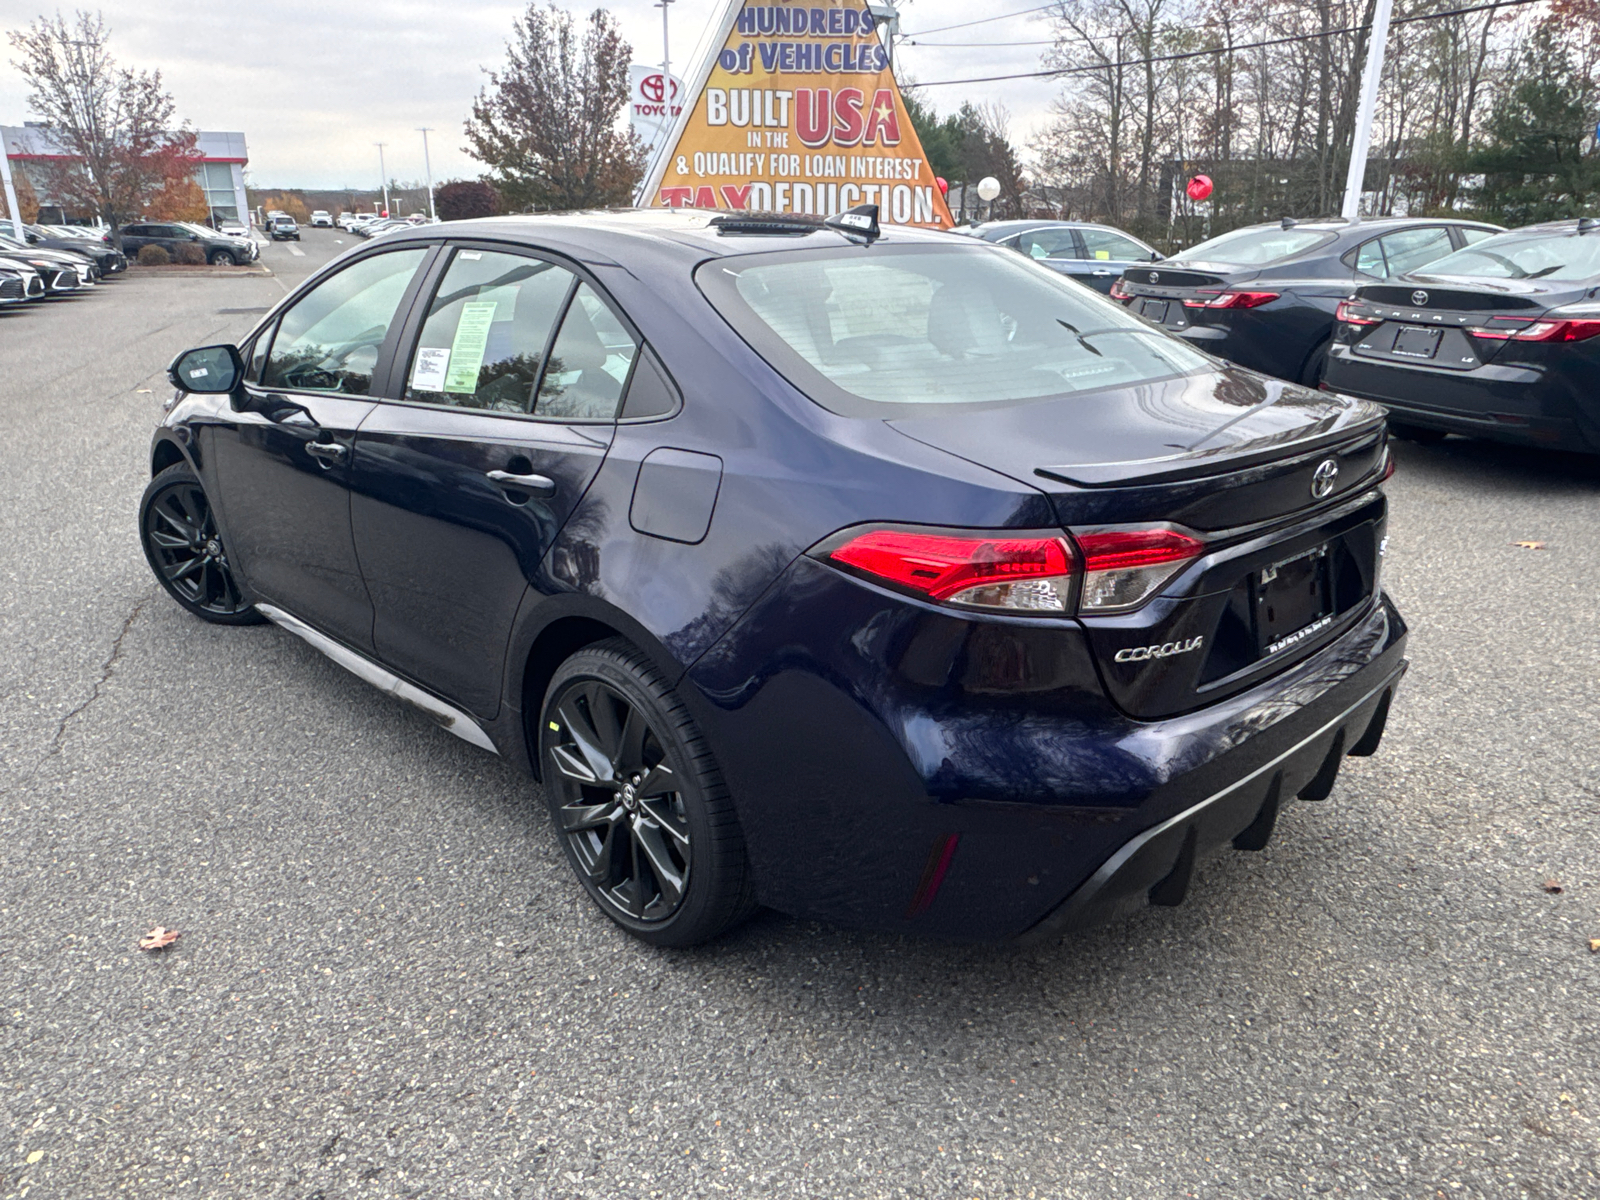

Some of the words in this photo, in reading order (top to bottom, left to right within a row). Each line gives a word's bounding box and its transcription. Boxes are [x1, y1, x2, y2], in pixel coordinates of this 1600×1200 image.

[737, 6, 876, 36] HUNDREDS
[719, 42, 754, 74] of
[758, 42, 889, 74] VEHICLES
[706, 87, 793, 127] BUILT
[795, 87, 901, 147] USA
[747, 131, 763, 148] IN
[765, 131, 789, 149] THE
[676, 154, 690, 175] &
[693, 152, 765, 177] QUALIFY
[769, 153, 800, 178] FOR
[805, 154, 846, 178] LOAN
[851, 156, 923, 180] INTEREST
[660, 185, 752, 210] TAX
[750, 182, 941, 224] DEDUCTION.
[1375, 309, 1467, 323] CAMRY
[1114, 635, 1203, 662] COROLLA
